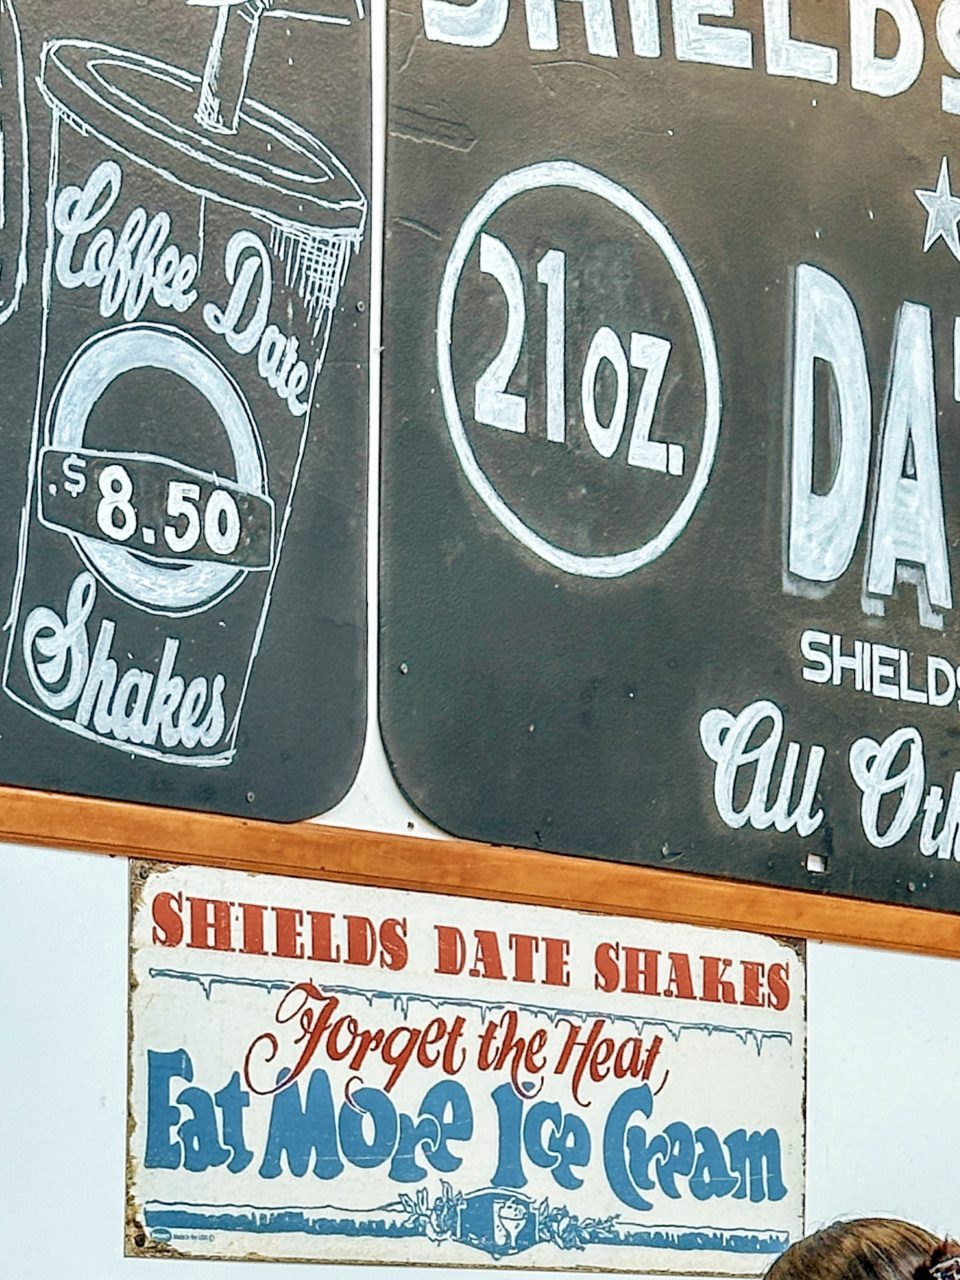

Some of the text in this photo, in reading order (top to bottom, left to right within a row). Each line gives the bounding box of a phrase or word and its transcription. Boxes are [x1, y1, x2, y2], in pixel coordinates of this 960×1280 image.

[54, 160, 309, 416] Coffee Date
[473, 231, 567, 444] 21
[22, 570, 227, 749] Shakes
[698, 698, 827, 840] All
[150, 890, 793, 1012] SHIELDS DATE SHAKES
[143, 1046, 789, 1212] Eat More Ice Cream
[244, 979, 670, 1114] Forget the Heat
